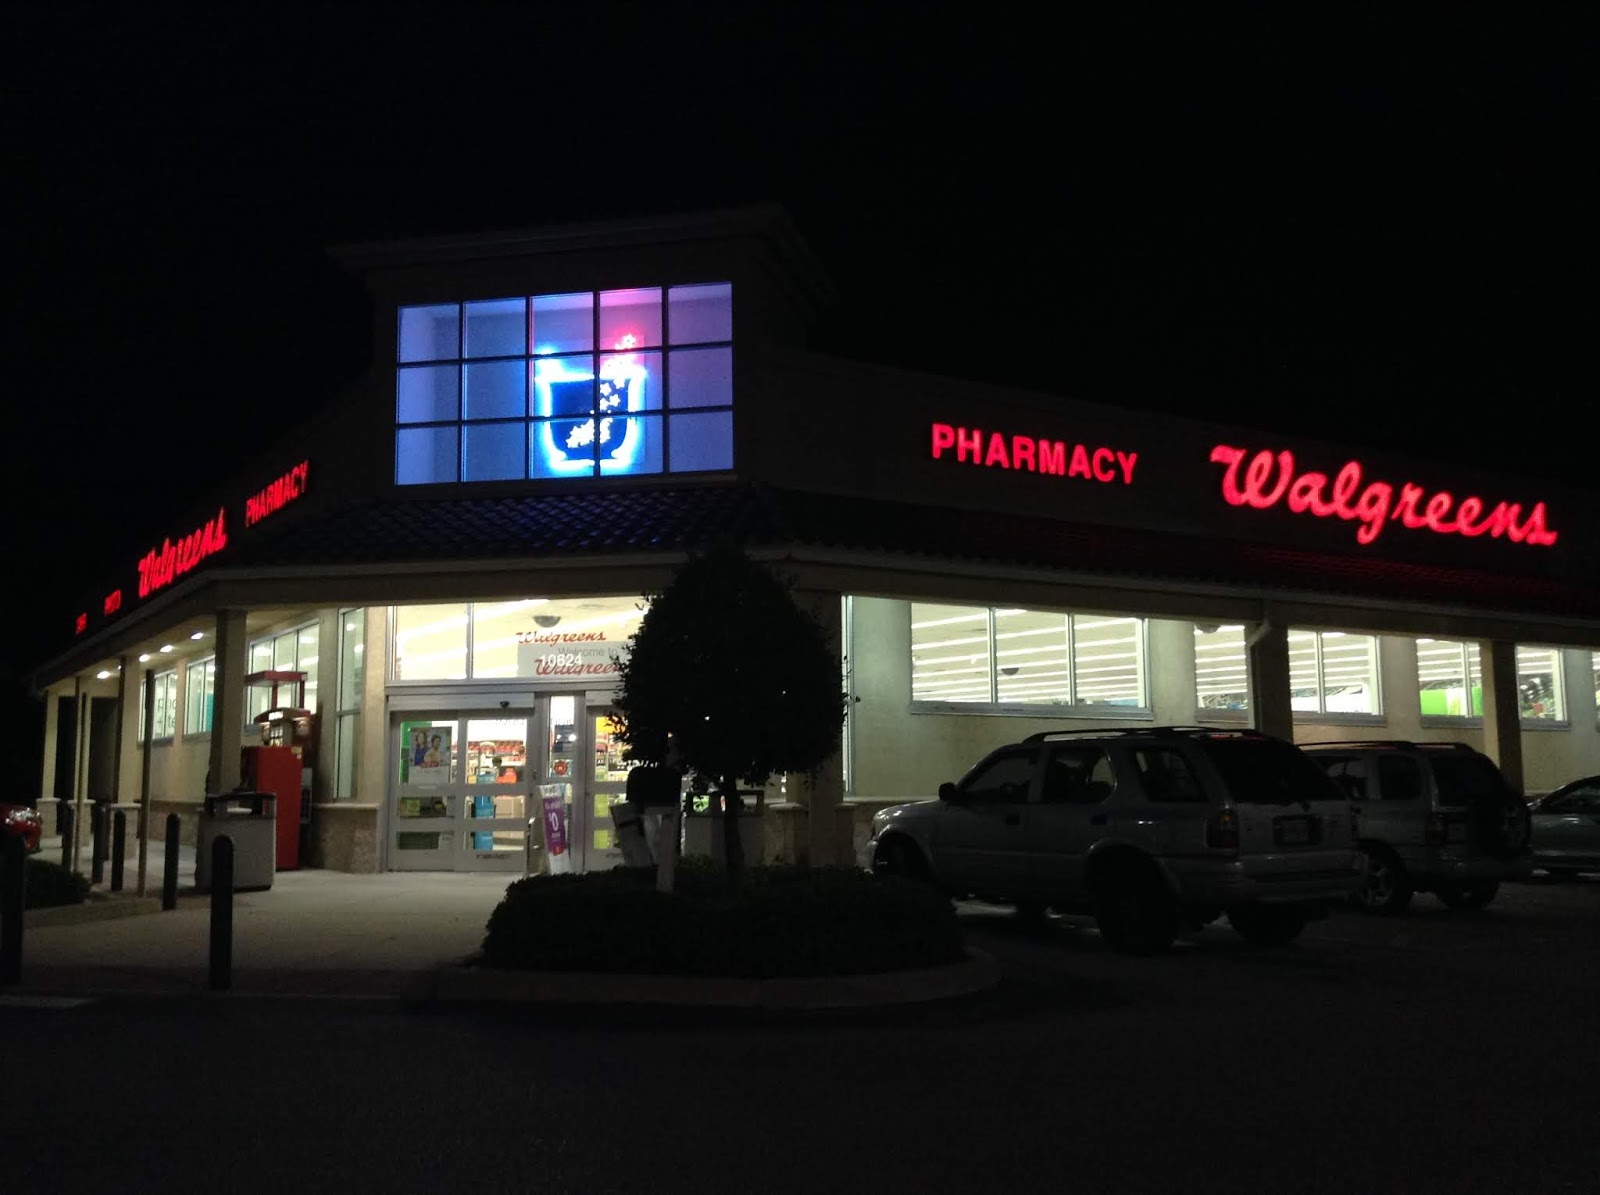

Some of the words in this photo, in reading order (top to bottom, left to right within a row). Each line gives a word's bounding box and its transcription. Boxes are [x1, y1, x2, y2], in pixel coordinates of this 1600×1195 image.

[931, 423, 1138, 485] PHARMACY
[245, 460, 309, 527] PHARMACY
[1209, 444, 1558, 546] Walgreens
[136, 507, 228, 599] Walgreens
[515, 631, 607, 647] Walgreens
[540, 653, 583, 667] 10624
